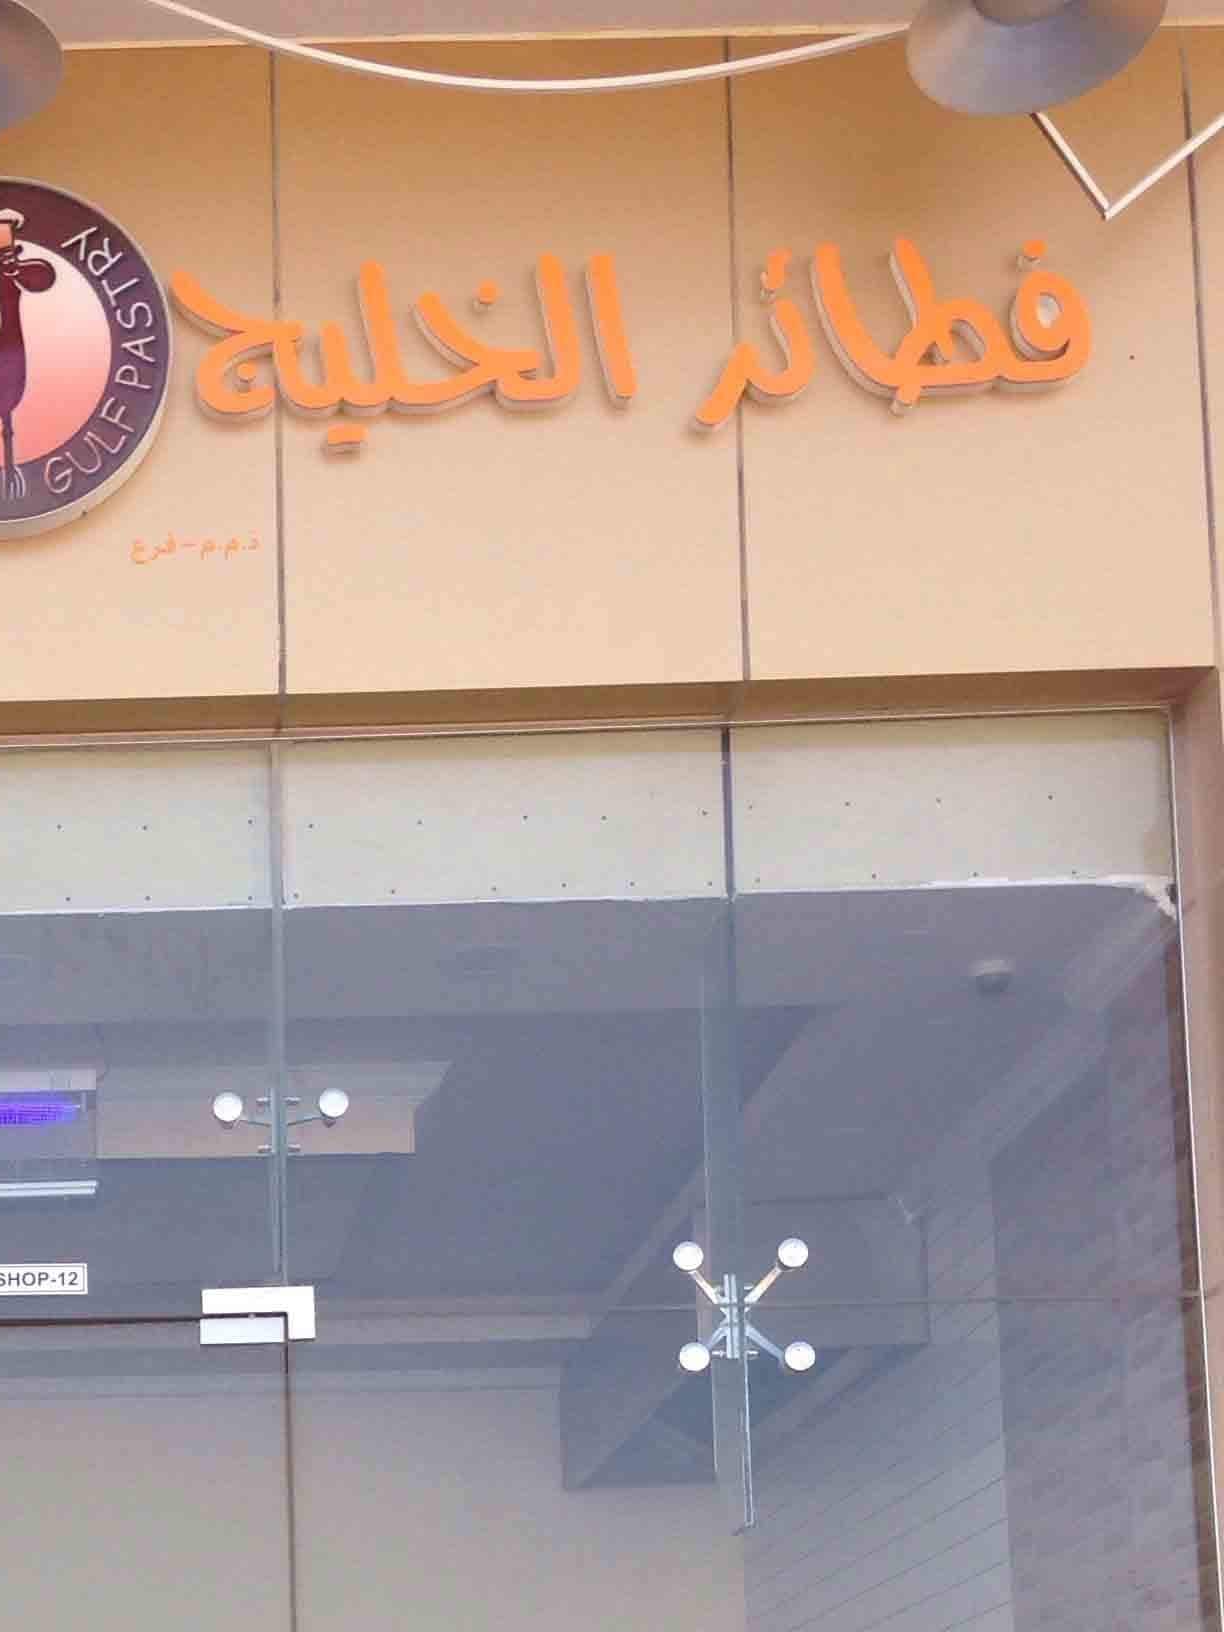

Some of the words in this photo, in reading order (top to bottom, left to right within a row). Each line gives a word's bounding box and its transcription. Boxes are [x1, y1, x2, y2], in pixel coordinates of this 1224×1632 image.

[62, 225, 157, 390] PASTRY
[170, 252, 639, 452] الخليج
[688, 236, 1093, 434] فطائر
[43, 398, 140, 494] GULF
